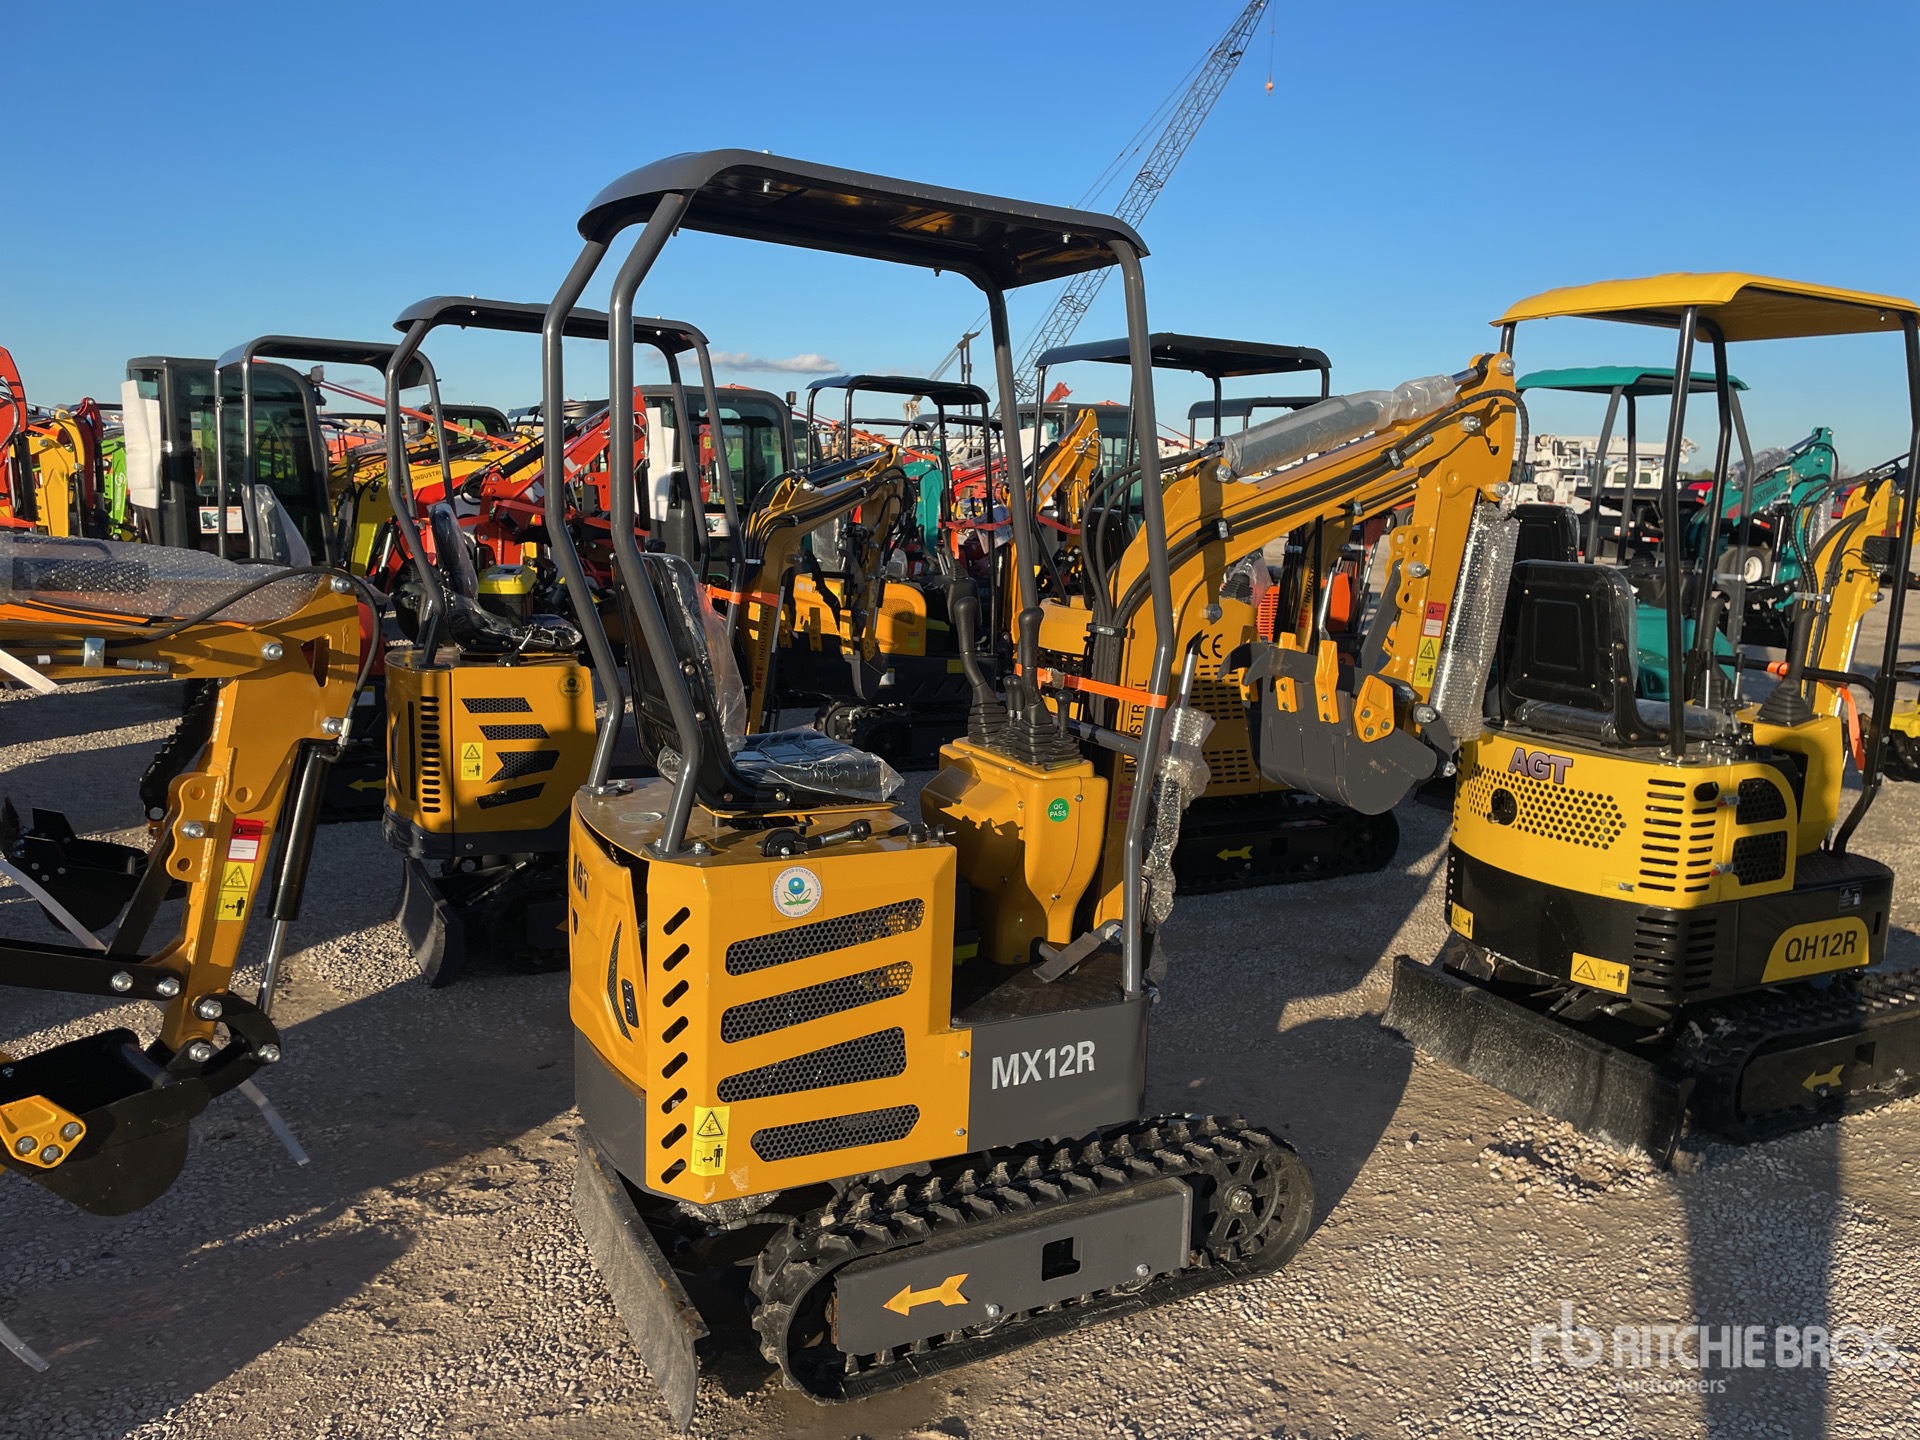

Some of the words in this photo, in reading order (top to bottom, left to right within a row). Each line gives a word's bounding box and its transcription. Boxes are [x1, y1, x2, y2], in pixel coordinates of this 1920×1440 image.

[1508, 746, 1574, 785] AGT
[1785, 930, 1858, 963] QH12R
[992, 1040, 1095, 1090] MX12R
